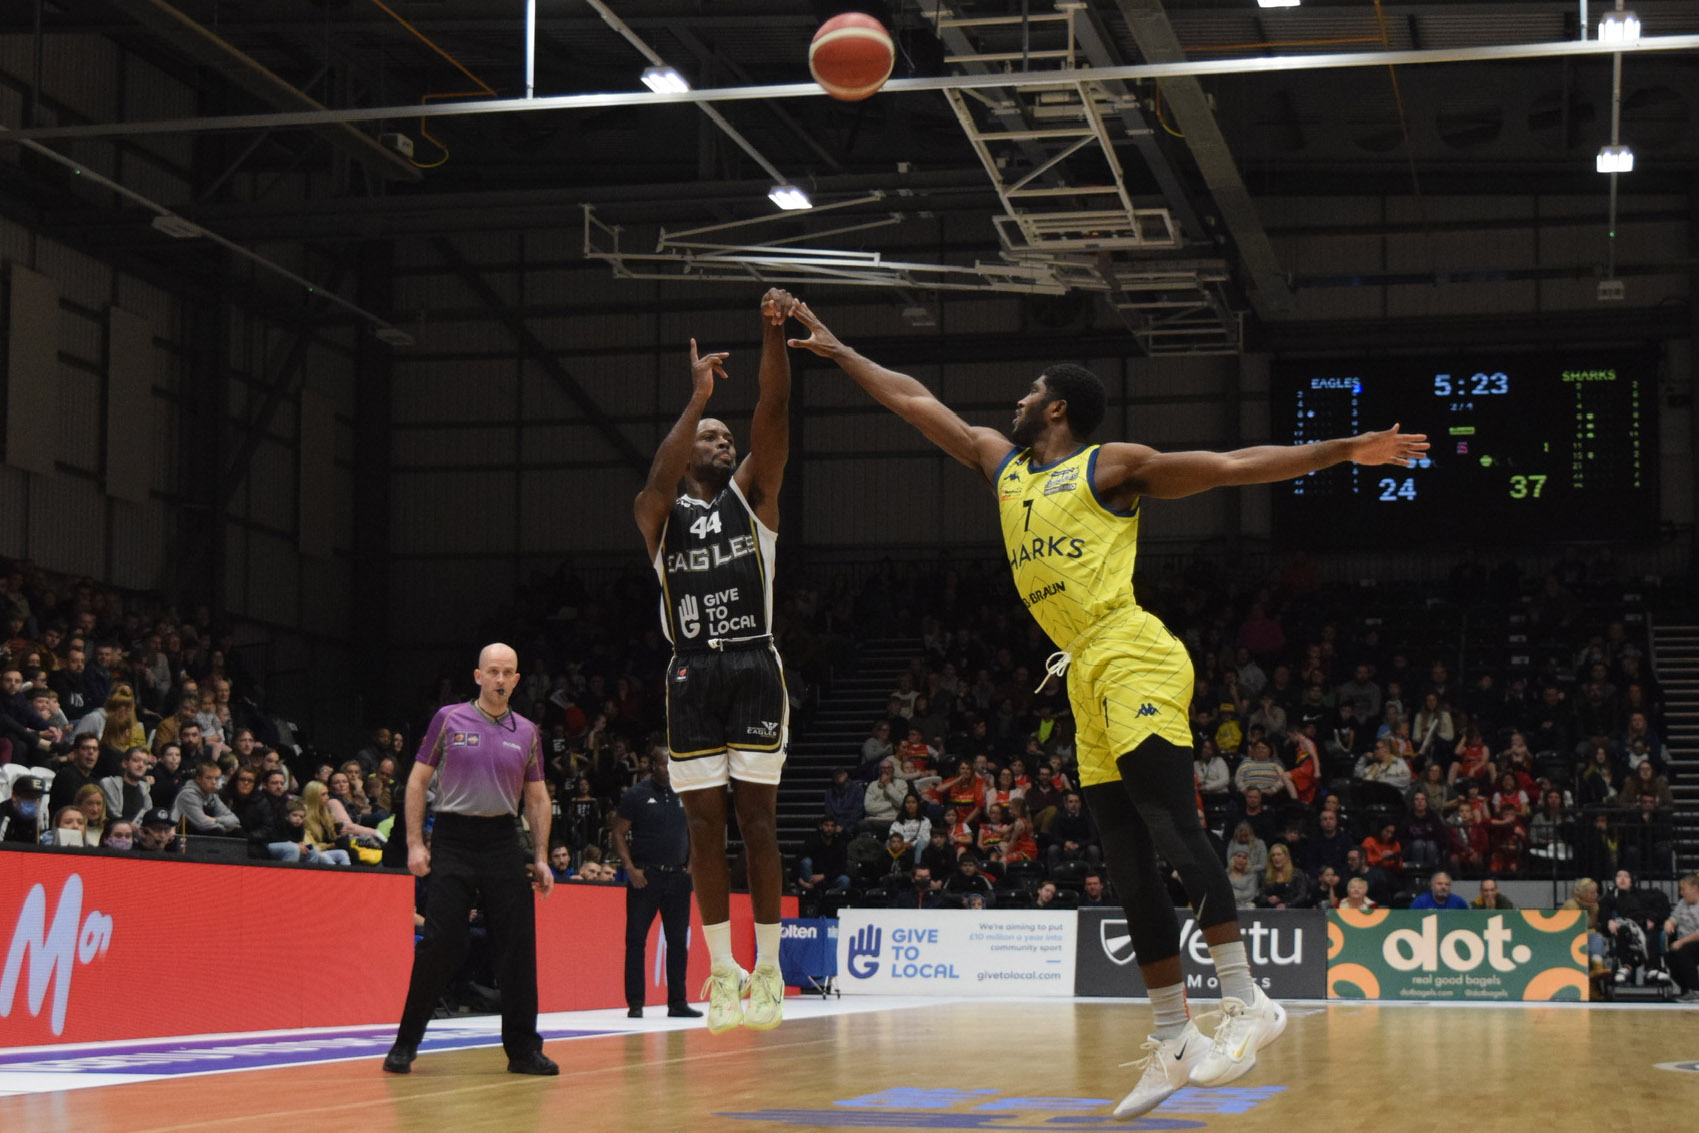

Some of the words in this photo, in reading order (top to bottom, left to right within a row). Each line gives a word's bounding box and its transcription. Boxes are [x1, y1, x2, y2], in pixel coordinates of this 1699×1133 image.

[1310, 376, 1361, 389] EAGLES
[1433, 372, 1509, 396] 5:23
[1561, 369, 1617, 382] SHARKS
[1378, 477, 1417, 502] 24
[1509, 474, 1548, 499] 37
[1023, 499, 1034, 532] 7
[690, 511, 722, 540] 44
[1010, 535, 1085, 570] HARKS
[703, 587, 740, 607] GIVE
[1030, 581, 1066, 605] BRAUN
[706, 605, 728, 622] TO
[708, 614, 757, 636] LOCAL
[780, 924, 817, 939] olten
[891, 928, 938, 943] GIVE
[1005, 923, 1036, 932] aiming
[1048, 923, 1063, 932] put
[990, 944, 1037, 952] community
[1039, 944, 1062, 952] sport
[1382, 913, 1532, 972] dot.
[891, 946, 920, 961] TO
[891, 963, 960, 979] LOCAL
[977, 970, 1061, 982] givetolocal.com
[1412, 974, 1432, 984] real
[1435, 974, 1463, 987] good
[1465, 973, 1501, 987] bagels
